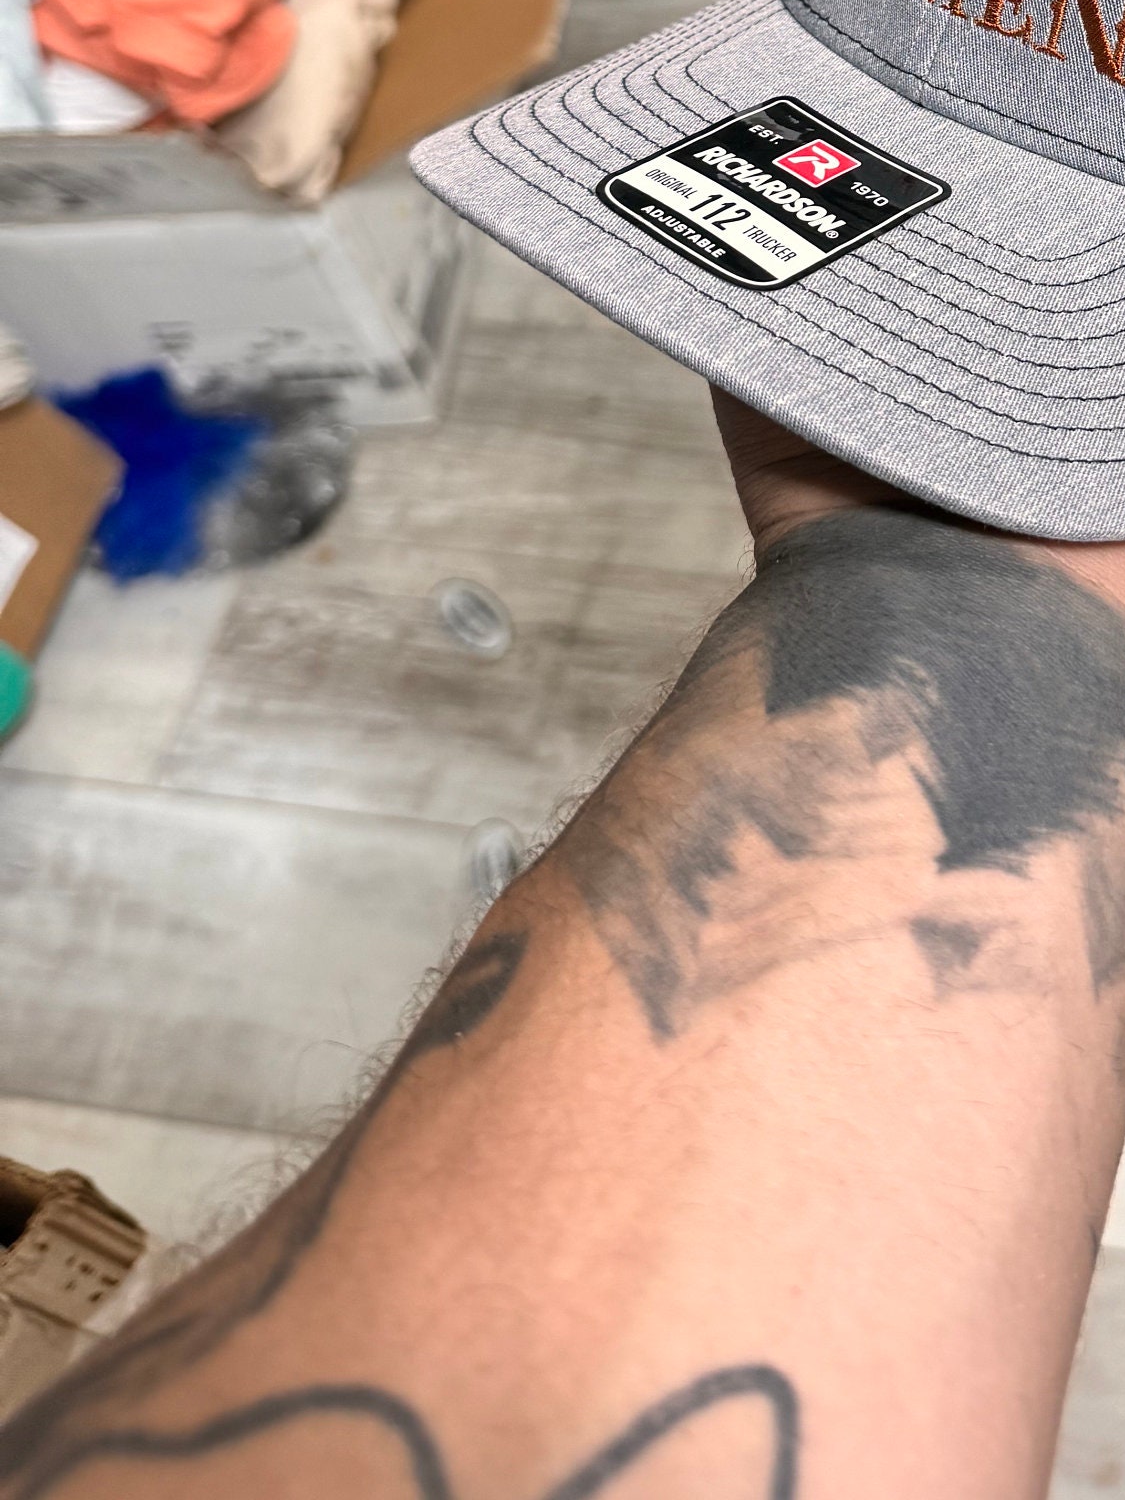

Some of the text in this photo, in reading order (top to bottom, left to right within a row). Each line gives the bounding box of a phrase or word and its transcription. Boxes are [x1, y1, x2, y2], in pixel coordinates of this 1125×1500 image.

[749, 124, 890, 207] EST. 1970
[641, 205, 726, 259] ADJUSTABLE
[645, 168, 797, 263] ORIGINAL 112 TRUCKER
